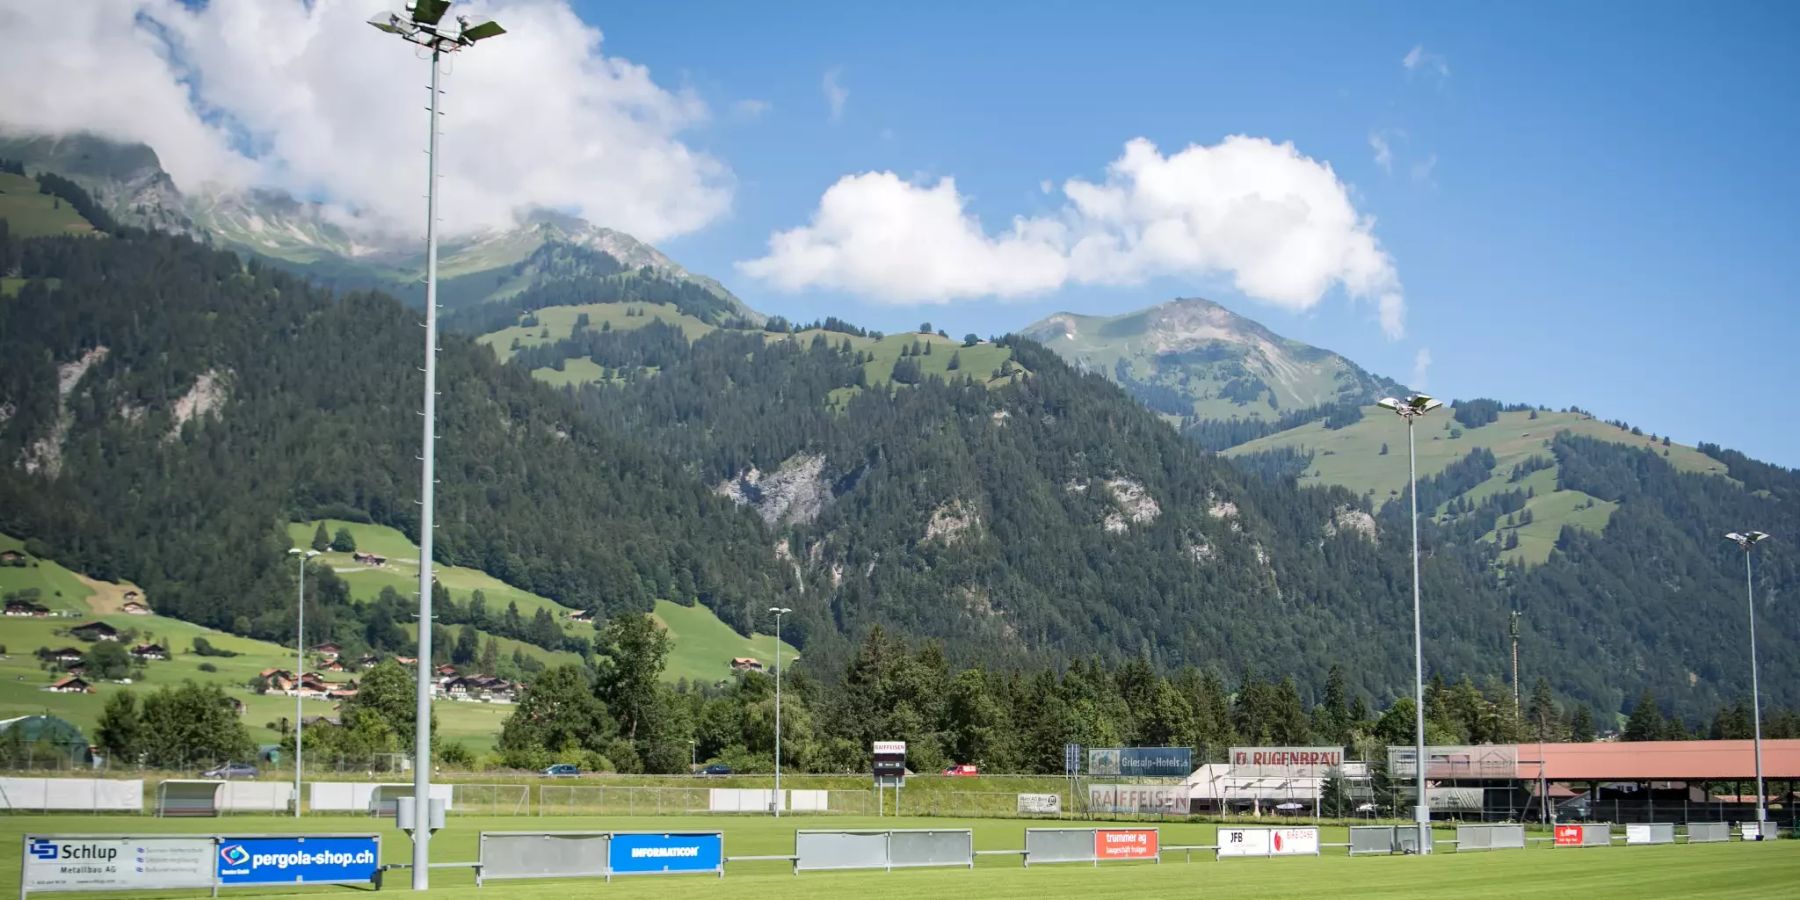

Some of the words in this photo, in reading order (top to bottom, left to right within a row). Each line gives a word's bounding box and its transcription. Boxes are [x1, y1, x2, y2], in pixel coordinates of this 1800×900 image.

[1253, 752, 1340, 766] RUGENBRÄU
[1091, 790, 1187, 809] RAIFFEISEN
[1106, 833, 1136, 843] trummer
[1138, 834, 1147, 845] ag
[1230, 832, 1243, 843] JFB
[62, 844, 117, 862] Schlup
[253, 850, 375, 869] pergola-shop.ch
